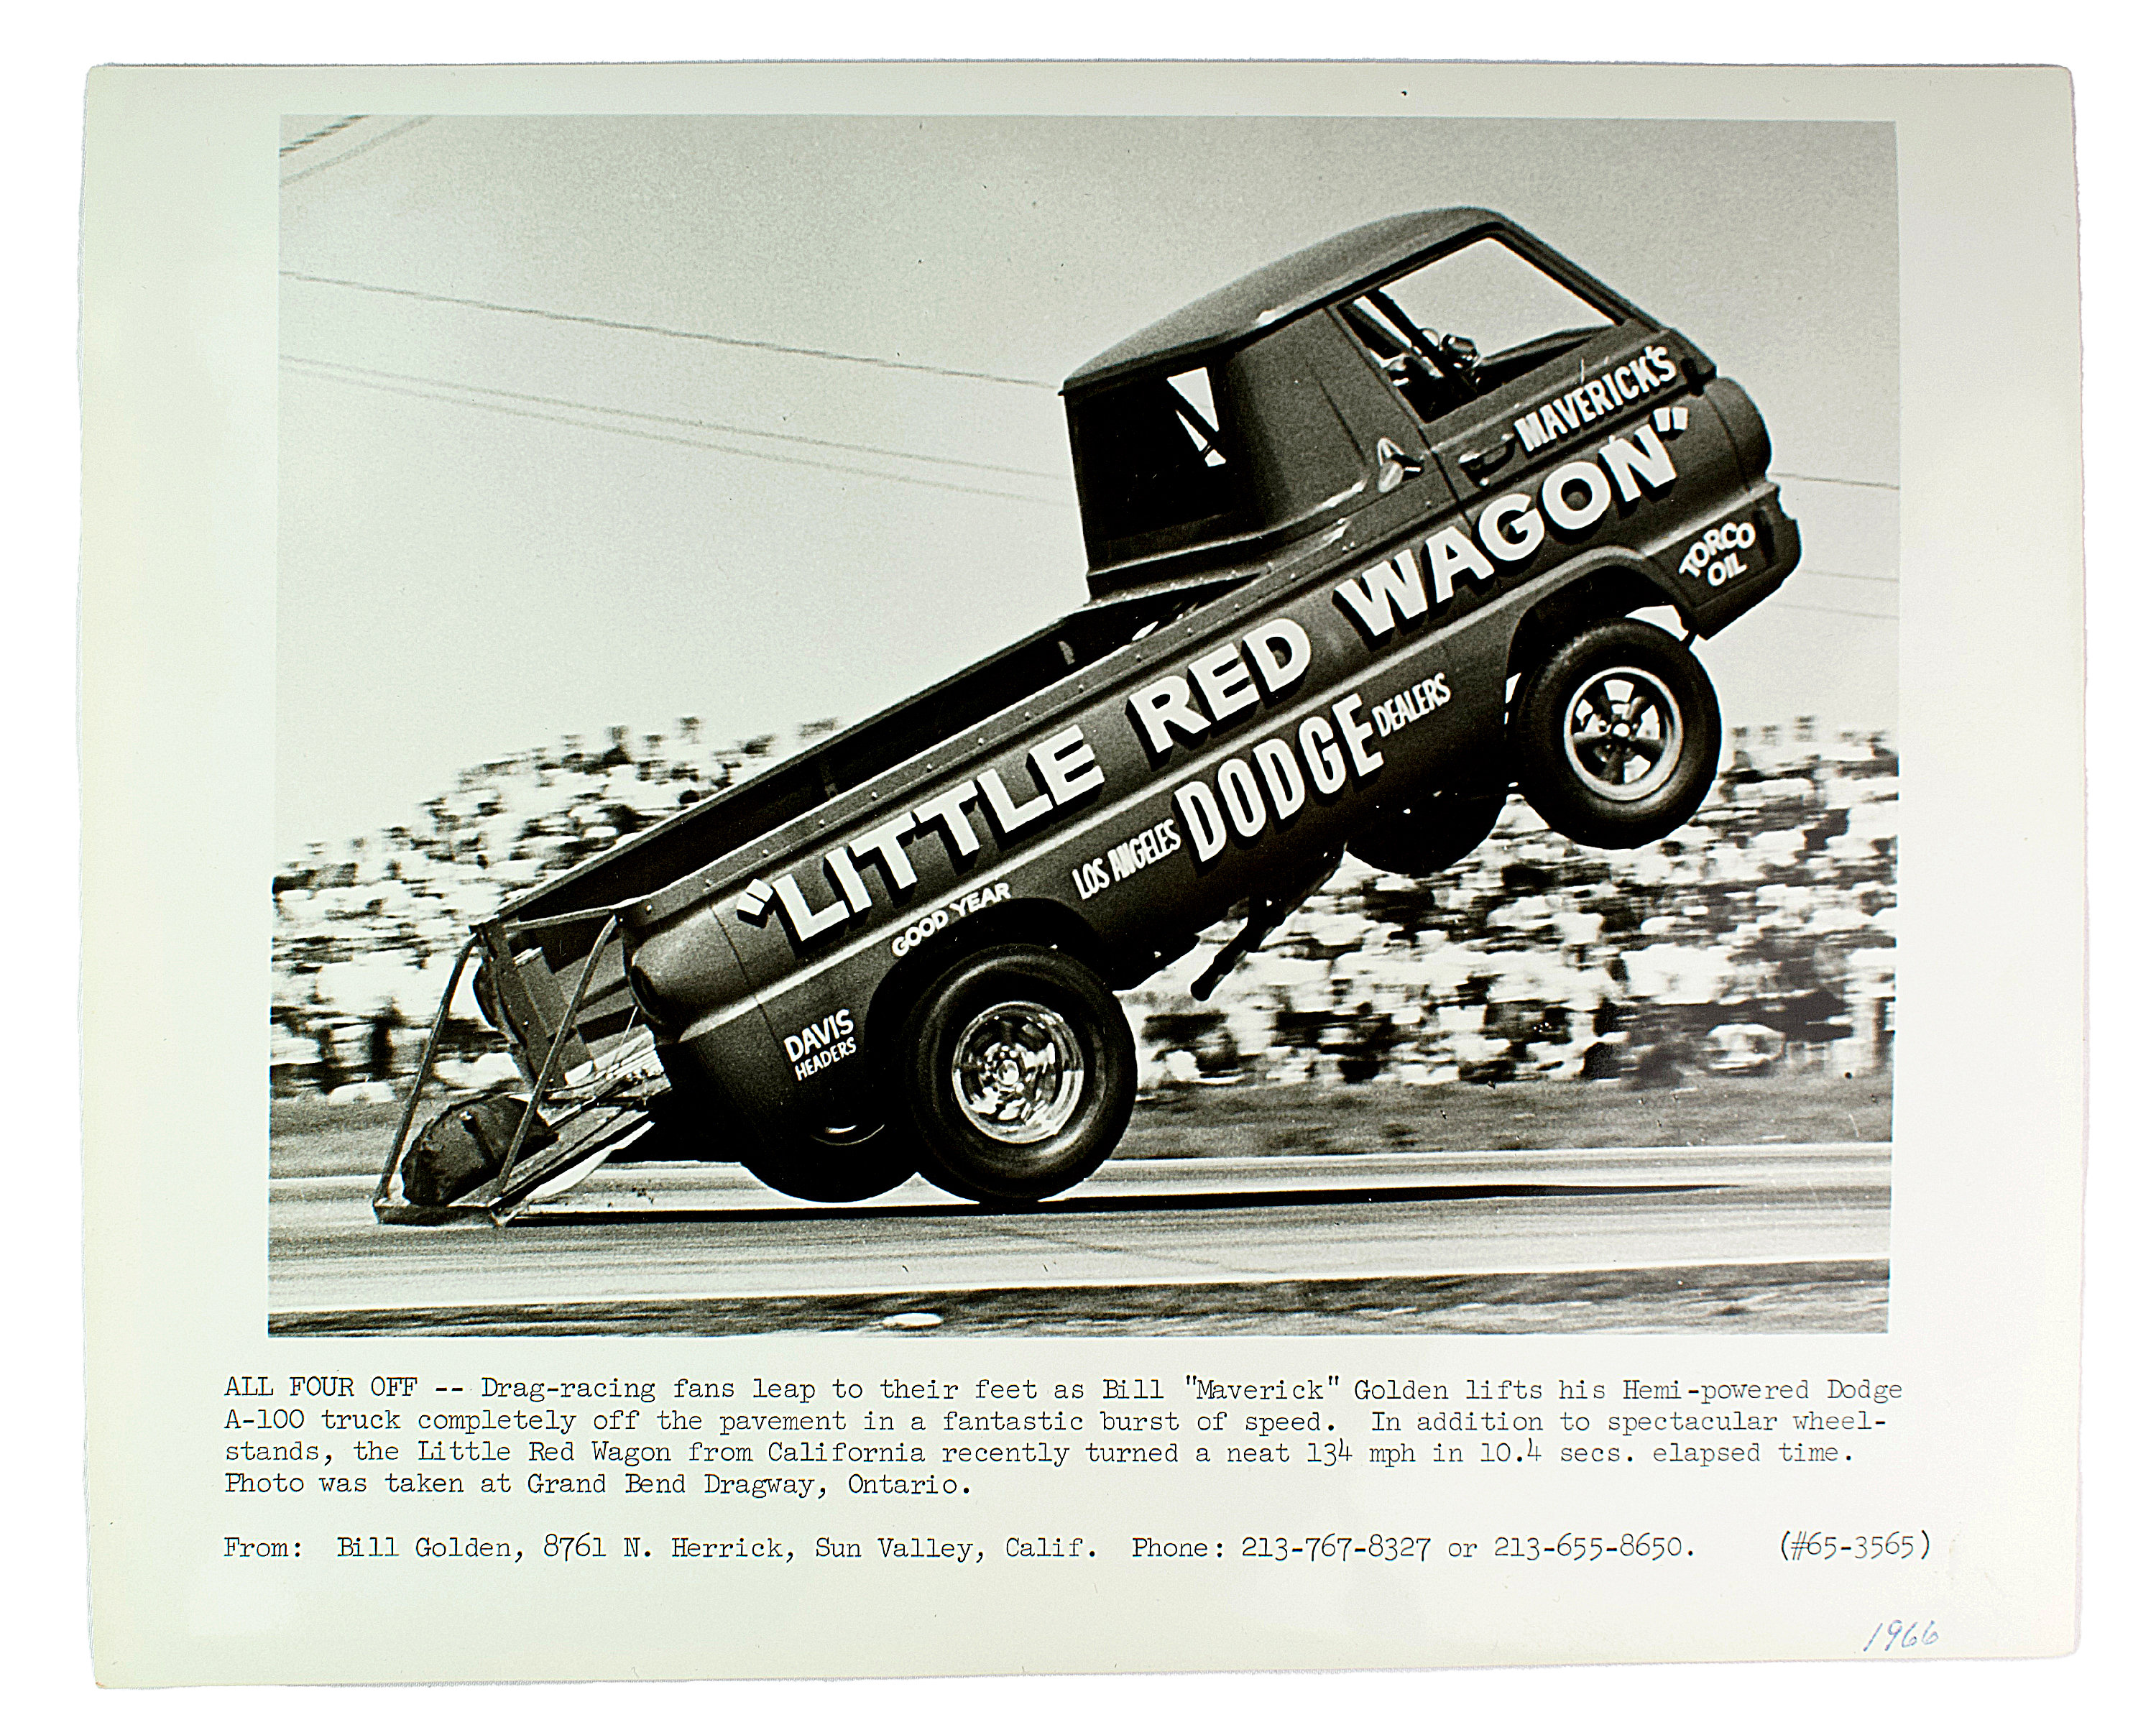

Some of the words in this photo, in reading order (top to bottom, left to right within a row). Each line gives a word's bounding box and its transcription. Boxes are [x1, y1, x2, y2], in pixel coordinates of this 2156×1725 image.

[1514, 346, 1677, 452] MAVERICK'S
[1679, 522, 1756, 579] TORCO
[1707, 553, 1747, 586] OIL
[737, 724, 1105, 942] "LITTLE
[1129, 617, 1312, 753] RED
[1335, 406, 1689, 637] WAGON"
[1072, 858, 1110, 899] LOS
[1110, 818, 1181, 883] ANGELES
[1174, 693, 1383, 862] DODGE
[1370, 671, 1451, 738] DEALERS
[783, 1009, 854, 1062] DAVIS
[795, 1037, 856, 1082] HEADERS
[224, 1376, 274, 1397] ALL
[289, 1375, 355, 1397] FOUR
[371, 1376, 418, 1397] OFF
[481, 1376, 655, 1403] Drag-racing
[673, 1378, 734, 1398] fans
[752, 1378, 816, 1404] leap
[831, 1378, 863, 1399] to
[880, 1379, 959, 1399] their
[975, 1379, 1038, 1399] feet
[1054, 1384, 1084, 1399] as
[1102, 1379, 1164, 1399] Bill
[1186, 1374, 1340, 1400] "Maverick"
[1354, 1379, 1450, 1400] Golden
[1465, 1379, 1542, 1399] lifts
[1558, 1379, 1606, 1399] his
[1623, 1379, 1810, 1404] Hemi-powered
[1827, 1379, 1902, 1404] Dodge
[224, 1409, 305, 1430] A-100
[321, 1409, 402, 1430] truck
[418, 1409, 577, 1435] completely
[594, 1409, 640, 1430] off
[656, 1409, 702, 1430] the
[719, 1410, 847, 1436] pavement
[864, 1410, 895, 1430] in
[911, 1416, 926, 1431] a
[943, 1410, 1083, 1431] fantastic
[1099, 1410, 1180, 1432] burst
[1197, 1411, 1227, 1431] of
[1245, 1411, 1335, 1438] speed.
[1371, 1411, 1401, 1432] In
[1416, 1411, 1544, 1431] addition
[1560, 1411, 1590, 1432] to
[1608, 1411, 1778, 1437] spectacular
[1792, 1410, 1886, 1430] wheel-
[226, 1440, 332, 1467] stands,
[353, 1440, 399, 1460] the
[418, 1440, 511, 1461] Little
[528, 1441, 575, 1461] Red
[591, 1440, 672, 1467] Wagon
[688, 1441, 754, 1462] from
[768, 1441, 926, 1463] California
[941, 1442, 1070, 1468] recently
[1084, 1442, 1179, 1463] turned
[1196, 1447, 1211, 1463] a
[1227, 1443, 1290, 1463] neat
[1307, 1438, 1353, 1467] 134
[1368, 1443, 1416, 1468] mph
[1433, 1443, 1464, 1463] in
[1480, 1437, 1542, 1463] 10.4
[1560, 1447, 1633, 1463] secs.
[1653, 1442, 1761, 1468] elapsed
[1777, 1442, 1852, 1462] time.
[224, 1472, 305, 1493] Photo
[318, 1477, 367, 1493] was
[384, 1472, 464, 1493] taken
[481, 1473, 512, 1493] at
[528, 1473, 607, 1494] Grand
[625, 1473, 686, 1494] Bend
[704, 1473, 826, 1499] Dragway,
[848, 1473, 969, 1495] Ontario.
[224, 1537, 301, 1558] From:
[336, 1536, 400, 1558] Bill
[415, 1537, 522, 1563] Golden,
[543, 1532, 607, 1563] 8761
[623, 1537, 651, 1558] N.
[671, 1537, 793, 1563] Herrick,
[816, 1536, 862, 1558] Sun
[877, 1537, 984, 1564] Valley,
[1005, 1537, 1095, 1558] Calif.
[1132, 1537, 1222, 1558] Phone:
[1242, 1532, 1432, 1563] 213-767-8327
[1448, 1542, 1478, 1558] or
[1494, 1532, 1693, 1562] 213-655-8650.
[1781, 1530, 1930, 1561] (#65-3565)
[1863, 1619, 1940, 1652] 1966
